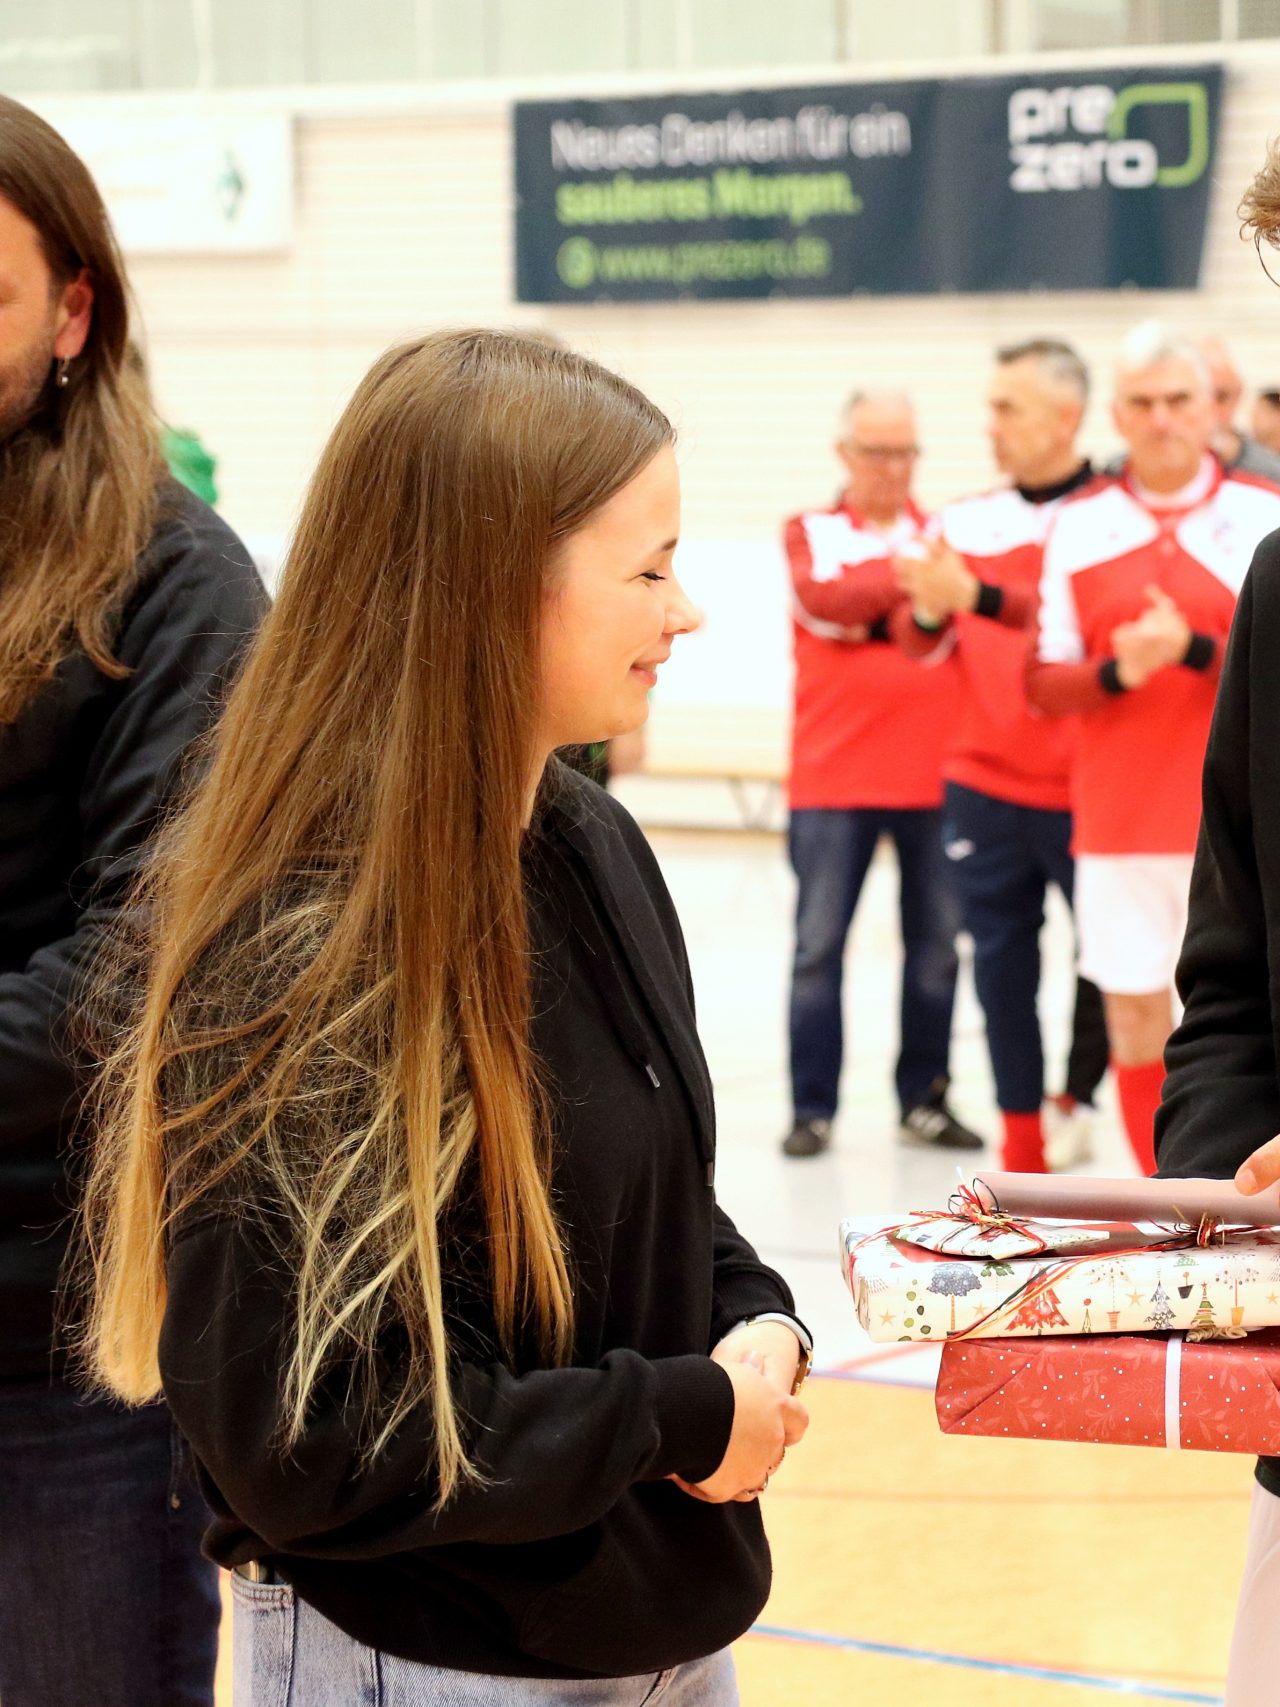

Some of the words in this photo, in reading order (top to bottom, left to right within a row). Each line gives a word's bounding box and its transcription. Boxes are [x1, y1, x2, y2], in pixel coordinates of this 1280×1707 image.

[551, 118, 660, 171] Neues
[661, 112, 792, 167] Denken
[796, 104, 848, 161] für
[850, 102, 911, 159] ein
[1009, 139, 1158, 193] zero
